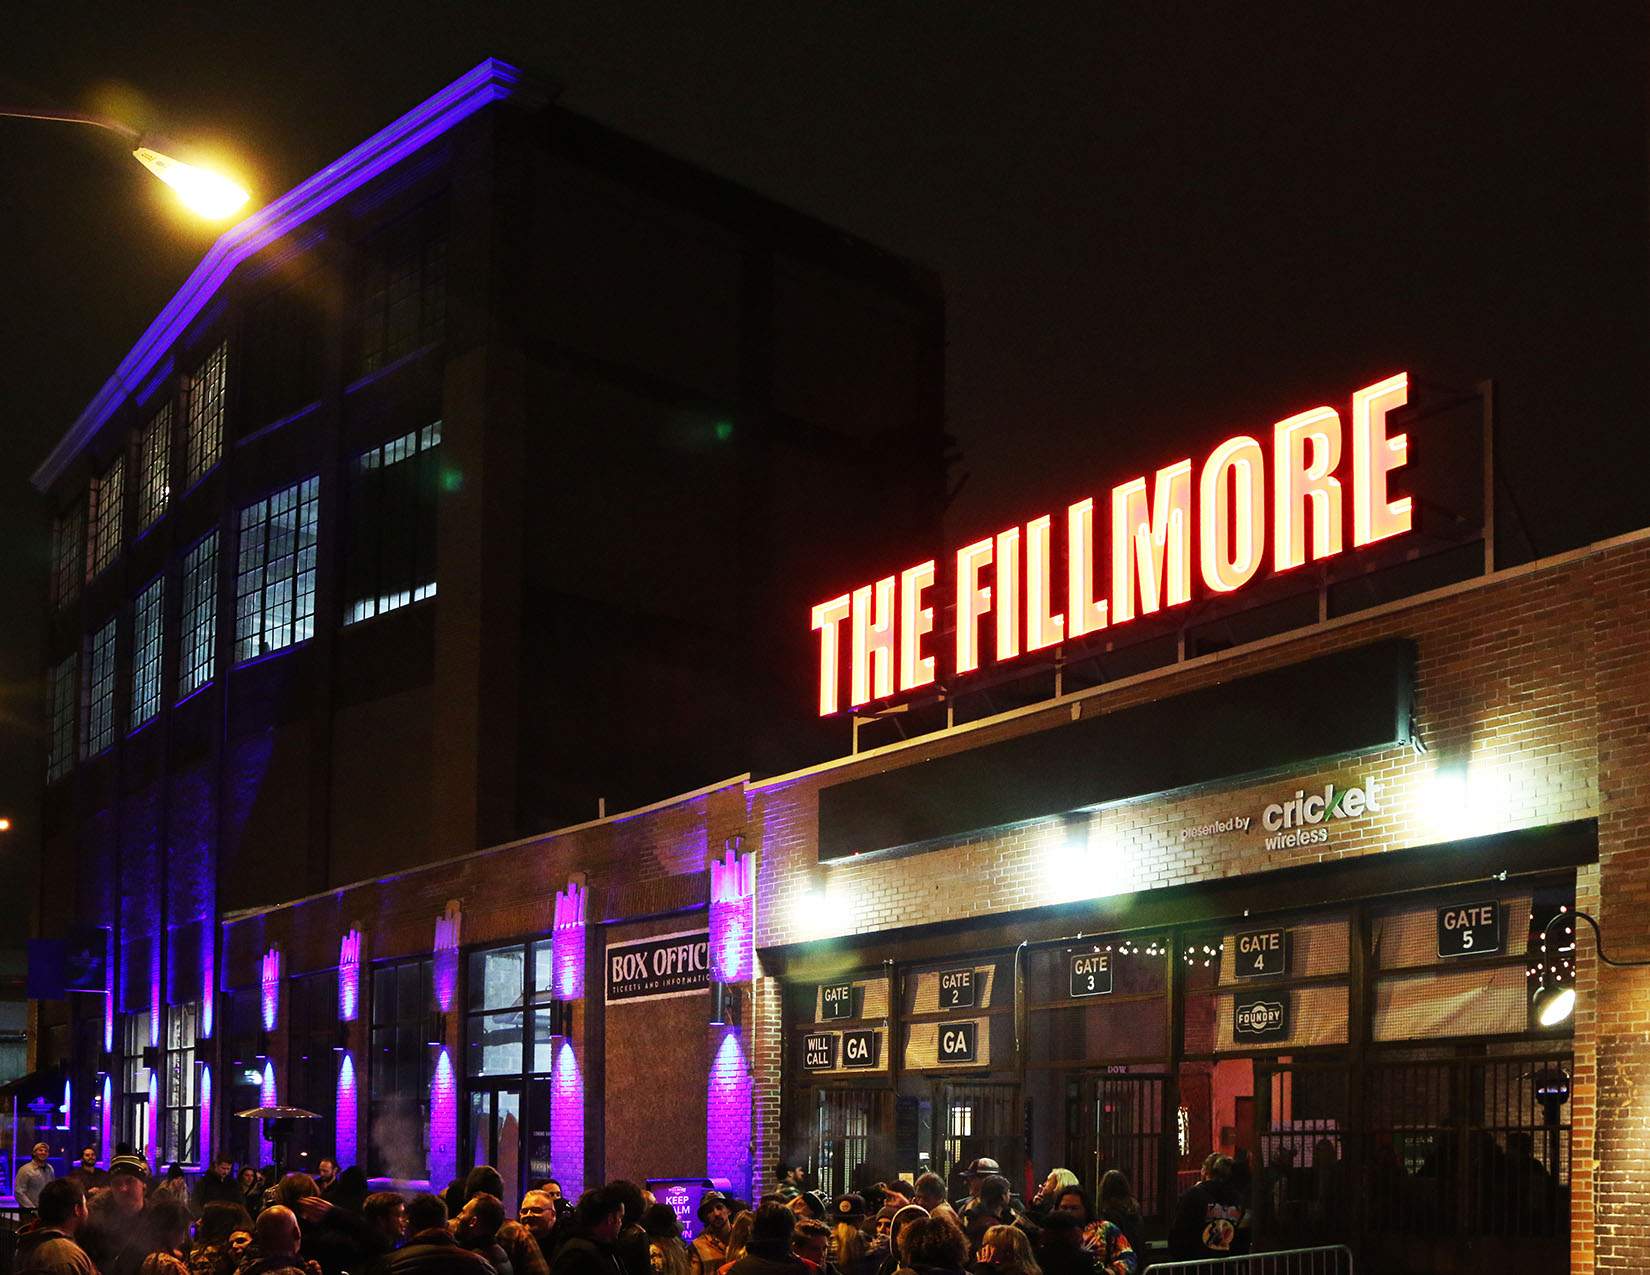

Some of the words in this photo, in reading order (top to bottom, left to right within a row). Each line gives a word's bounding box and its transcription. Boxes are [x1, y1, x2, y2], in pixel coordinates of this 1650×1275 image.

[812, 559, 935, 717] THE
[956, 372, 1412, 675] FILLMORE
[1262, 775, 1384, 833] cricket
[1181, 819, 1234, 840] presented
[1235, 816, 1251, 831] by
[1265, 827, 1328, 851] wireless
[1444, 906, 1493, 930] GATE
[1239, 933, 1280, 953] GATE
[1462, 930, 1474, 949] 5
[612, 951, 648, 983] BOX
[653, 942, 710, 977] OFFIC
[1074, 956, 1108, 975] GATE
[1254, 954, 1265, 970] 4
[612, 983, 641, 994] TICKETS
[645, 981, 659, 989] AND
[662, 974, 710, 987] INFORMATIO
[942, 972, 970, 989] GATE
[1087, 975, 1095, 991] 3
[824, 986, 849, 1002] GATE
[952, 990, 959, 1004] 2
[834, 1003, 839, 1015] 1
[1238, 1011, 1281, 1025] FOUNDRY
[808, 1036, 829, 1051] WILL
[847, 1037, 868, 1059] GA
[943, 1031, 967, 1054] GA
[806, 1052, 829, 1066] CALL
[665, 1196, 690, 1205] KEEP
